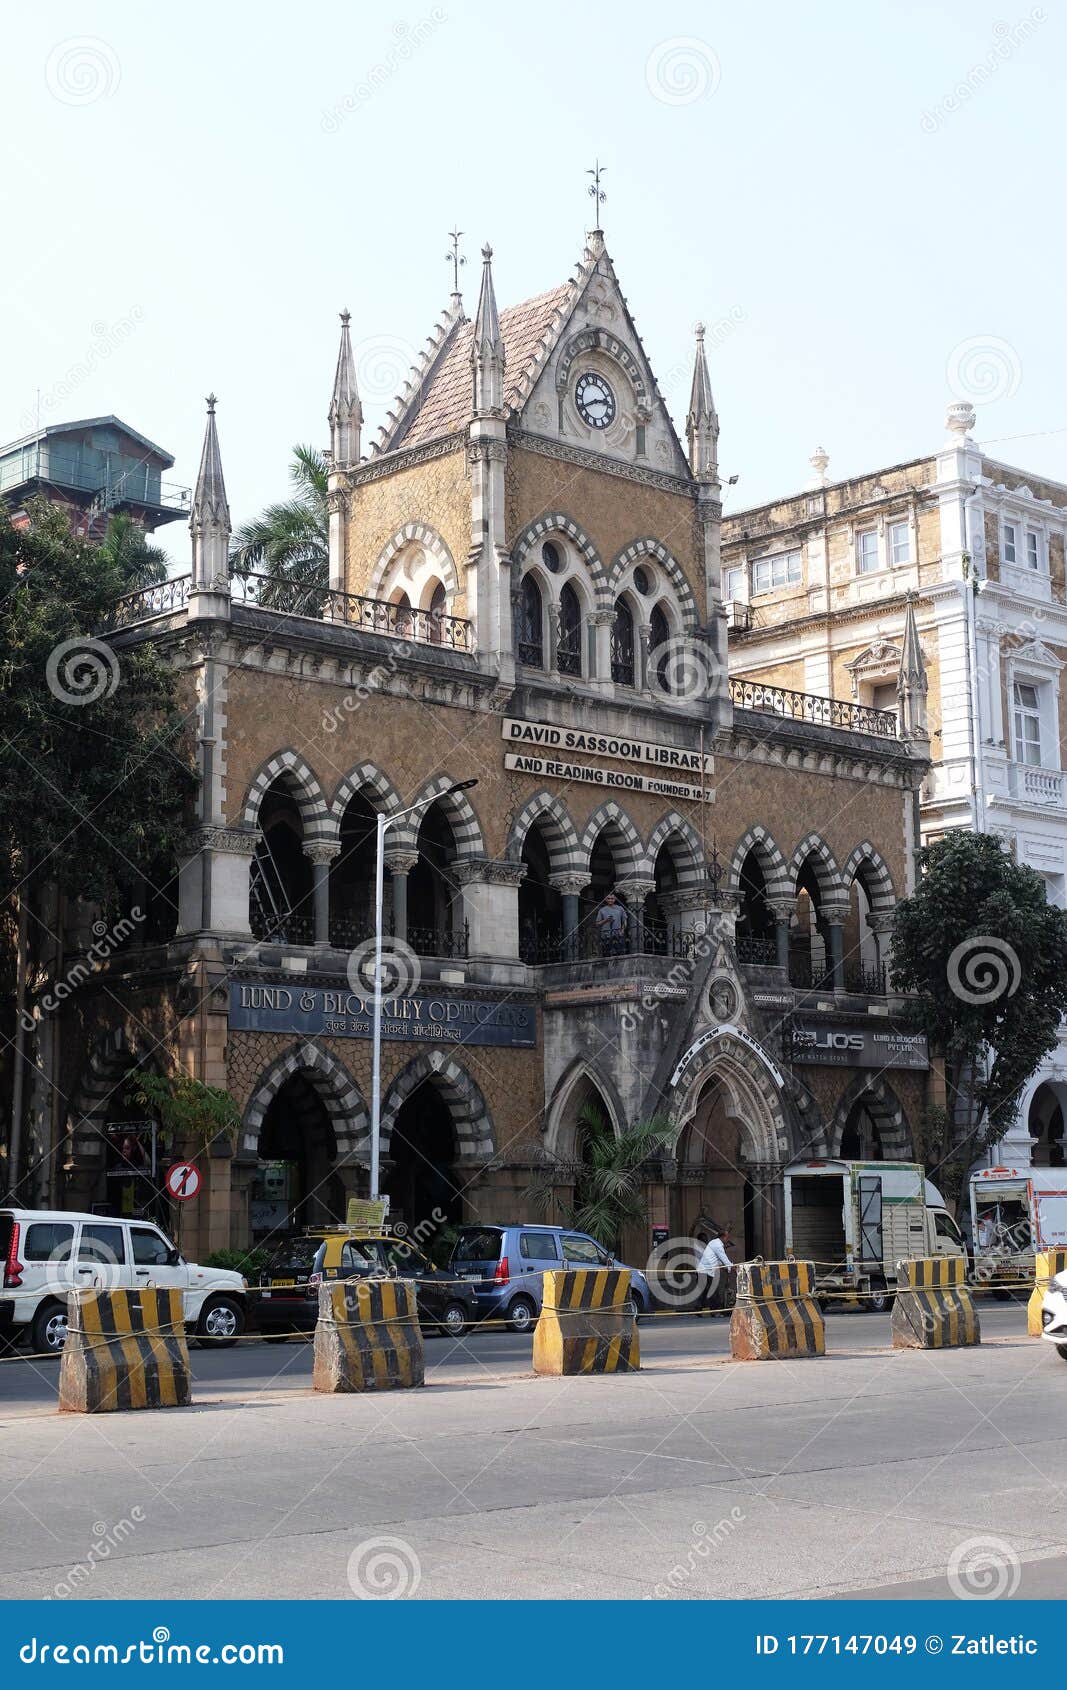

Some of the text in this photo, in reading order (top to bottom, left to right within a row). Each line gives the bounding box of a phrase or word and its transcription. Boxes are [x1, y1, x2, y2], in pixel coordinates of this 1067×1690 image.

[510, 723, 710, 771] DAVID SASSOON LIBRARY
[514, 756, 543, 773] AND
[546, 762, 605, 784] READING
[606, 771, 644, 790] ROOM
[647, 781, 691, 798] FOUNDED
[240, 986, 293, 1011] LUND
[299, 990, 318, 1013] &
[322, 992, 424, 1022] BLOCKLEY
